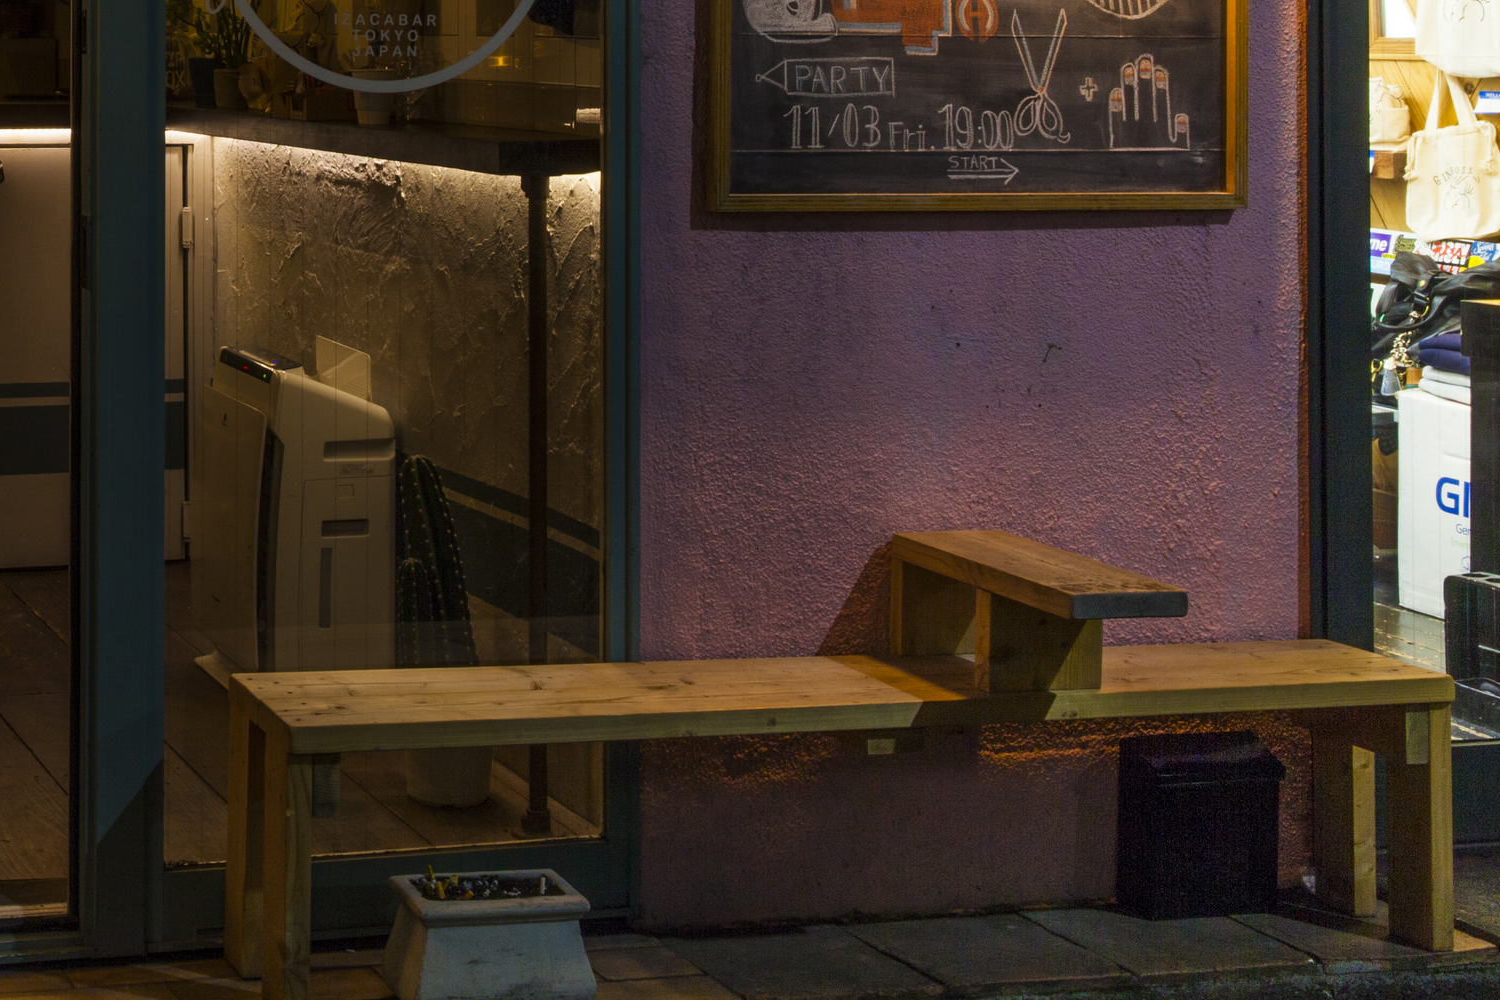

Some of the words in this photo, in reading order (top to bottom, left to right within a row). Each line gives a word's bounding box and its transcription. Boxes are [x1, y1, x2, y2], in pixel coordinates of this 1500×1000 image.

[334, 13, 437, 27] IZACABAR
[352, 29, 419, 42] TOKYO
[352, 44, 418, 58] JAPAN
[794, 64, 891, 94] PARTY
[783, 103, 881, 149] 11/03
[938, 103, 1015, 150] 19:00
[948, 155, 999, 170] START
